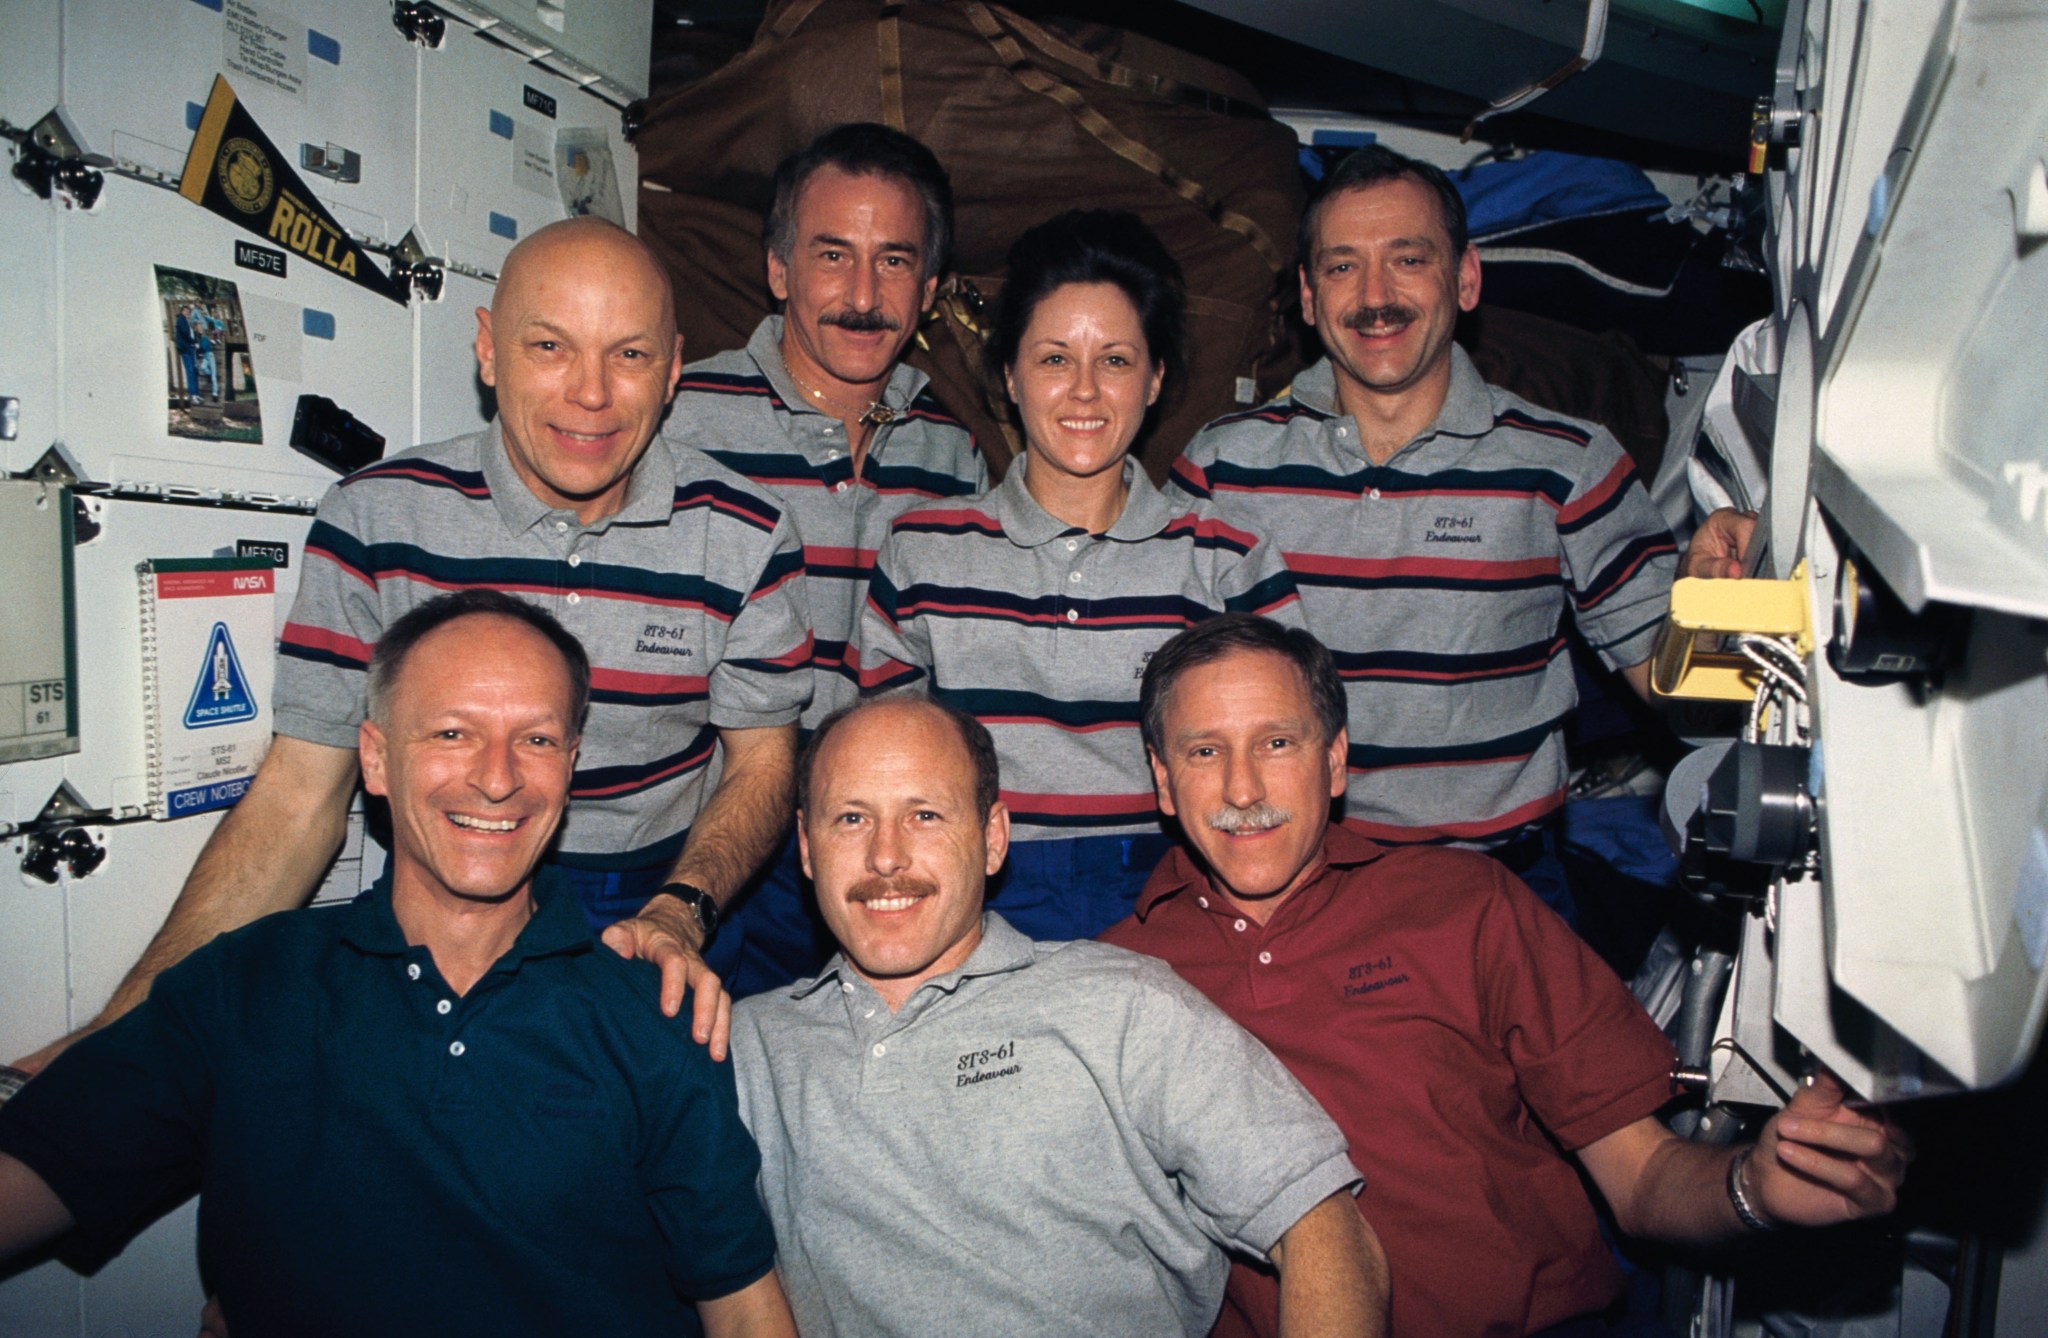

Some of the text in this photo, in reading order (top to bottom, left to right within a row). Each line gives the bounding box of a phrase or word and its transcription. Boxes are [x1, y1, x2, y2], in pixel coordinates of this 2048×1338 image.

[243, 15, 263, 32] Battery
[265, 25, 287, 41] Charger
[268, 195, 357, 278] ROLLA
[239, 246, 282, 272] MF57E
[1434, 516, 1474, 529] STS-61
[1424, 530, 1482, 543] Endeavour
[233, 575, 267, 591] NASA
[643, 624, 685, 641] STS-61
[635, 640, 694, 657] Endeavour
[30, 682, 64, 704] STS
[36, 711, 50, 724] 61
[196, 703, 247, 718] SPACE SHUTTLE
[211, 744, 237, 756] STS-61
[197, 768, 221, 781] Claude
[174, 790, 208, 809] CREW
[1348, 955, 1393, 980] STS-61
[1343, 973, 1410, 998] Endeavour
[956, 1040, 1015, 1071] STS-61
[955, 1063, 1023, 1088] Endeavour
